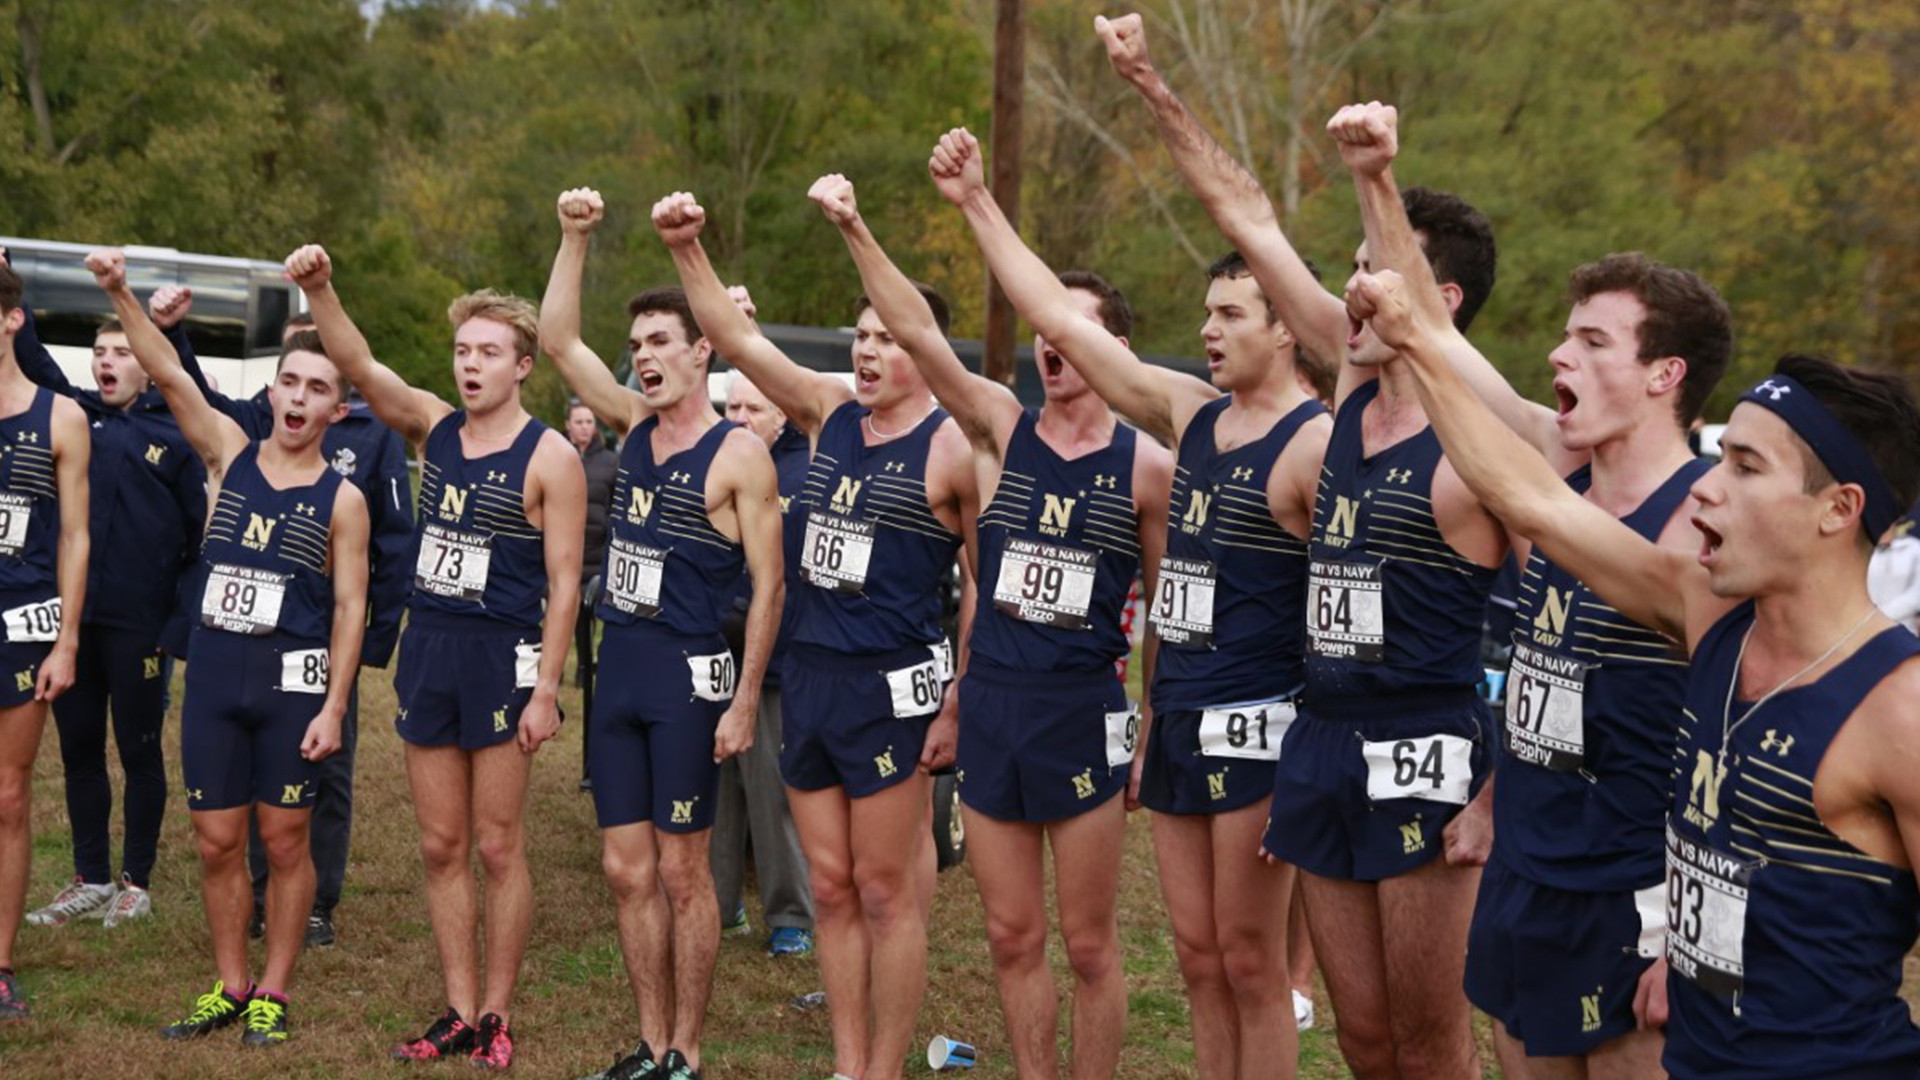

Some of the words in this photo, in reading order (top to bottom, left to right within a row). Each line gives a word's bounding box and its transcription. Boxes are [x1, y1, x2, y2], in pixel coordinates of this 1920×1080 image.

[439, 483, 468, 516] N
[627, 486, 654, 518] N
[832, 475, 862, 507] N
[1183, 489, 1212, 527] N
[826, 517, 840, 527] VS
[840, 520, 869, 533] NAVY
[1039, 492, 1076, 529] N
[1326, 494, 1360, 538] N
[243, 512, 276, 545] N
[446, 531, 459, 541] VS
[460, 534, 486, 546] NAVY
[434, 544, 464, 580] 73
[813, 531, 845, 571] 66
[1009, 541, 1040, 554] ARMY
[1042, 546, 1056, 557] VS
[1058, 549, 1090, 564] NAVY
[1173, 559, 1184, 573] VS
[1185, 562, 1210, 576] NAVY
[213, 563, 237, 575] ARMY
[239, 567, 252, 578] VS
[254, 570, 281, 583] NAVY
[615, 557, 640, 594] 90
[1022, 562, 1064, 605] 99
[1326, 564, 1341, 576] VS
[1343, 565, 1374, 579] NAVY
[221, 581, 257, 616] 89
[1019, 606, 1055, 622] Rizzo
[1160, 578, 1188, 621] 91
[1317, 584, 1352, 634] 64
[1533, 585, 1574, 635] N
[213, 615, 255, 633] Murphy
[1313, 637, 1356, 656] Bowers
[1531, 650, 1544, 667] VS
[1545, 655, 1578, 676] NAVY
[303, 654, 329, 685] 89
[709, 656, 731, 694] 90
[911, 666, 939, 707] 66
[1516, 674, 1550, 734] 67
[1226, 709, 1268, 750] 91
[1392, 740, 1445, 789] 64
[1510, 735, 1552, 766] Brophy
[1689, 748, 1728, 820] N
[1681, 839, 1697, 863] VS
[1699, 849, 1741, 880] NAVY
[1669, 868, 1704, 945] 93
[1581, 995, 1600, 1023] N
